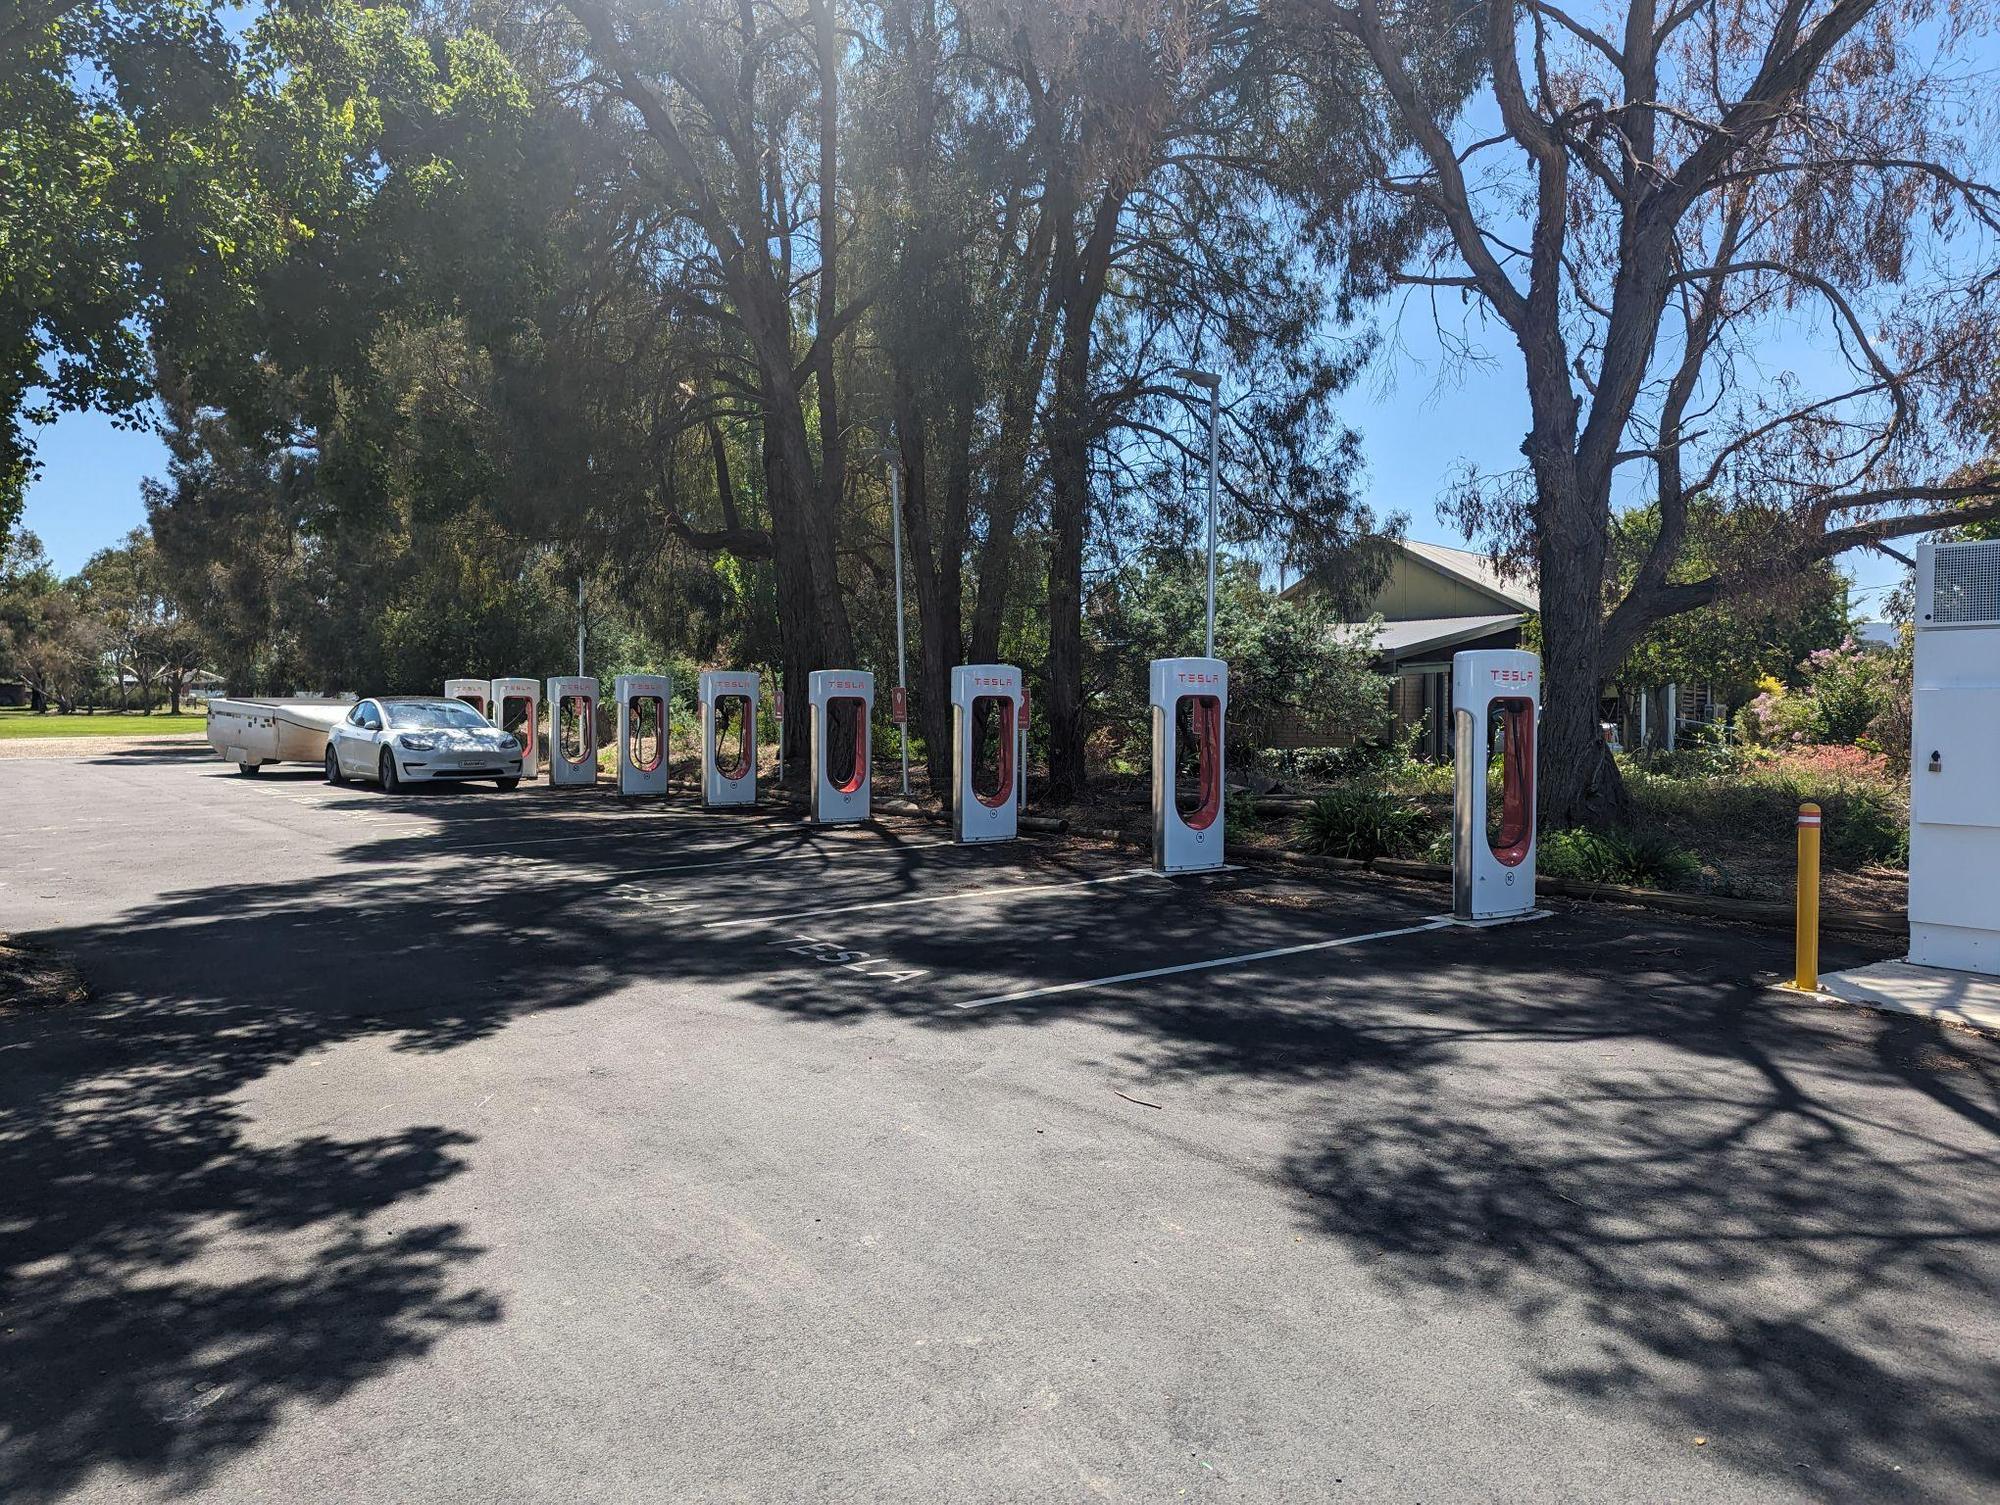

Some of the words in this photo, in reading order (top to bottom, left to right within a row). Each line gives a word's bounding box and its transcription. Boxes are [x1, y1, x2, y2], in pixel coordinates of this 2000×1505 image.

[1178, 673, 1219, 683] TESLA
[1490, 670, 1533, 682] TESLA
[630, 682, 662, 690] TESLA
[715, 680, 750, 688] TESLA
[828, 681, 865, 689] TESLA
[974, 677, 1012, 687] TESLA
[504, 684, 532, 692] TESLA
[561, 683, 592, 691] TESLA
[766, 934, 931, 984] TESLA
